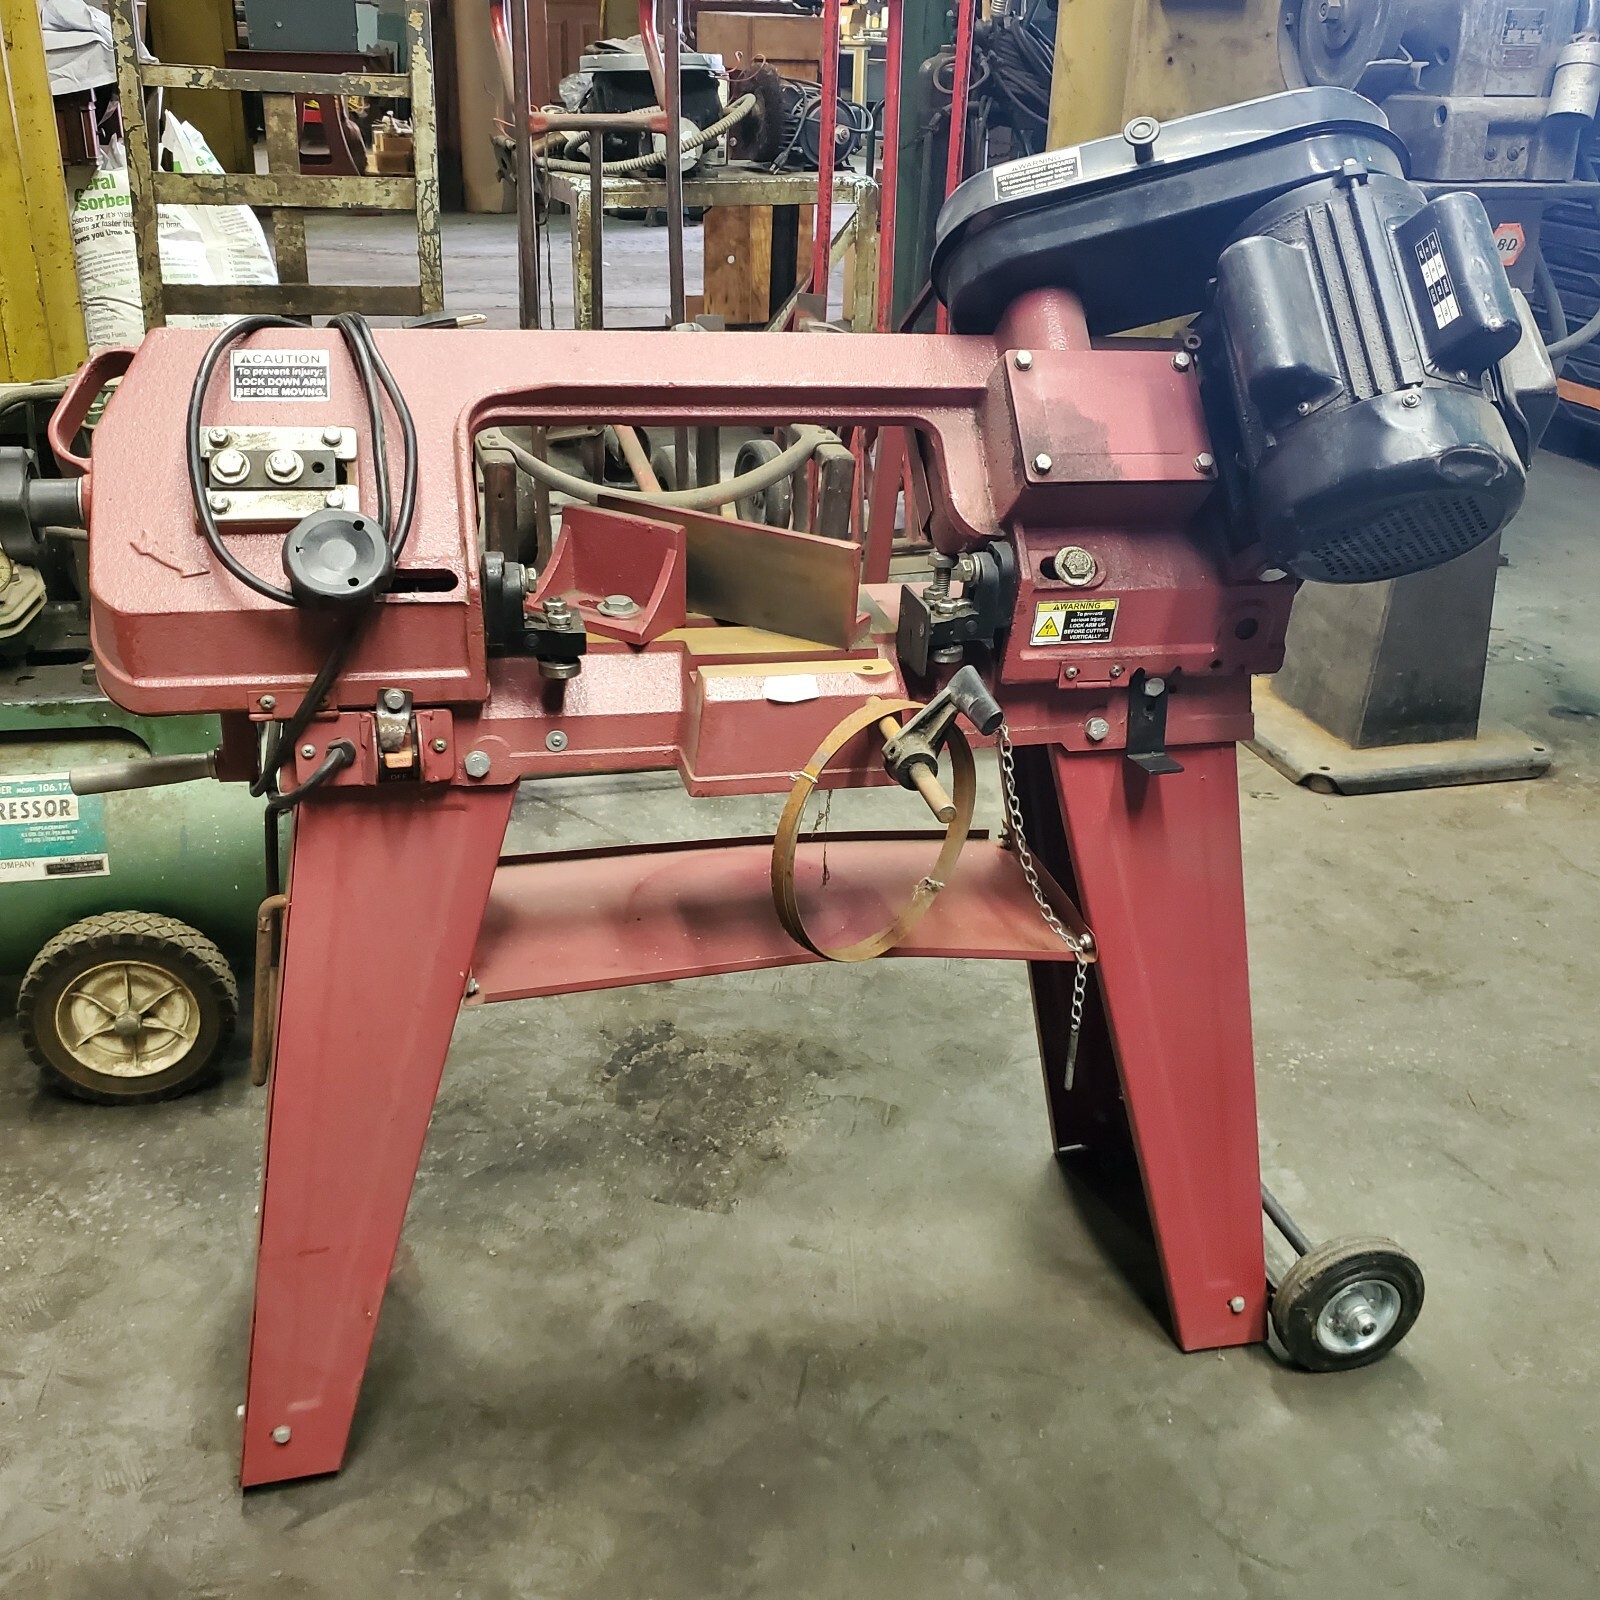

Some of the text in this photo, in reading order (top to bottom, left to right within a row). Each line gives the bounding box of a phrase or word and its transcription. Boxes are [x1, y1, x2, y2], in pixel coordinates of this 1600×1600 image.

[1019, 155, 1061, 169] WARNING
[252, 354, 320, 364] CAUTION
[237, 367, 324, 378] To prevent injury:
[235, 377, 326, 386] LOCK DOWN ARM
[235, 387, 326, 396] BEFORE MOVING.
[1060, 602, 1101, 610] WARNING
[0, 785, 12, 795] ER
[0, 861, 36, 869] OMPANY
